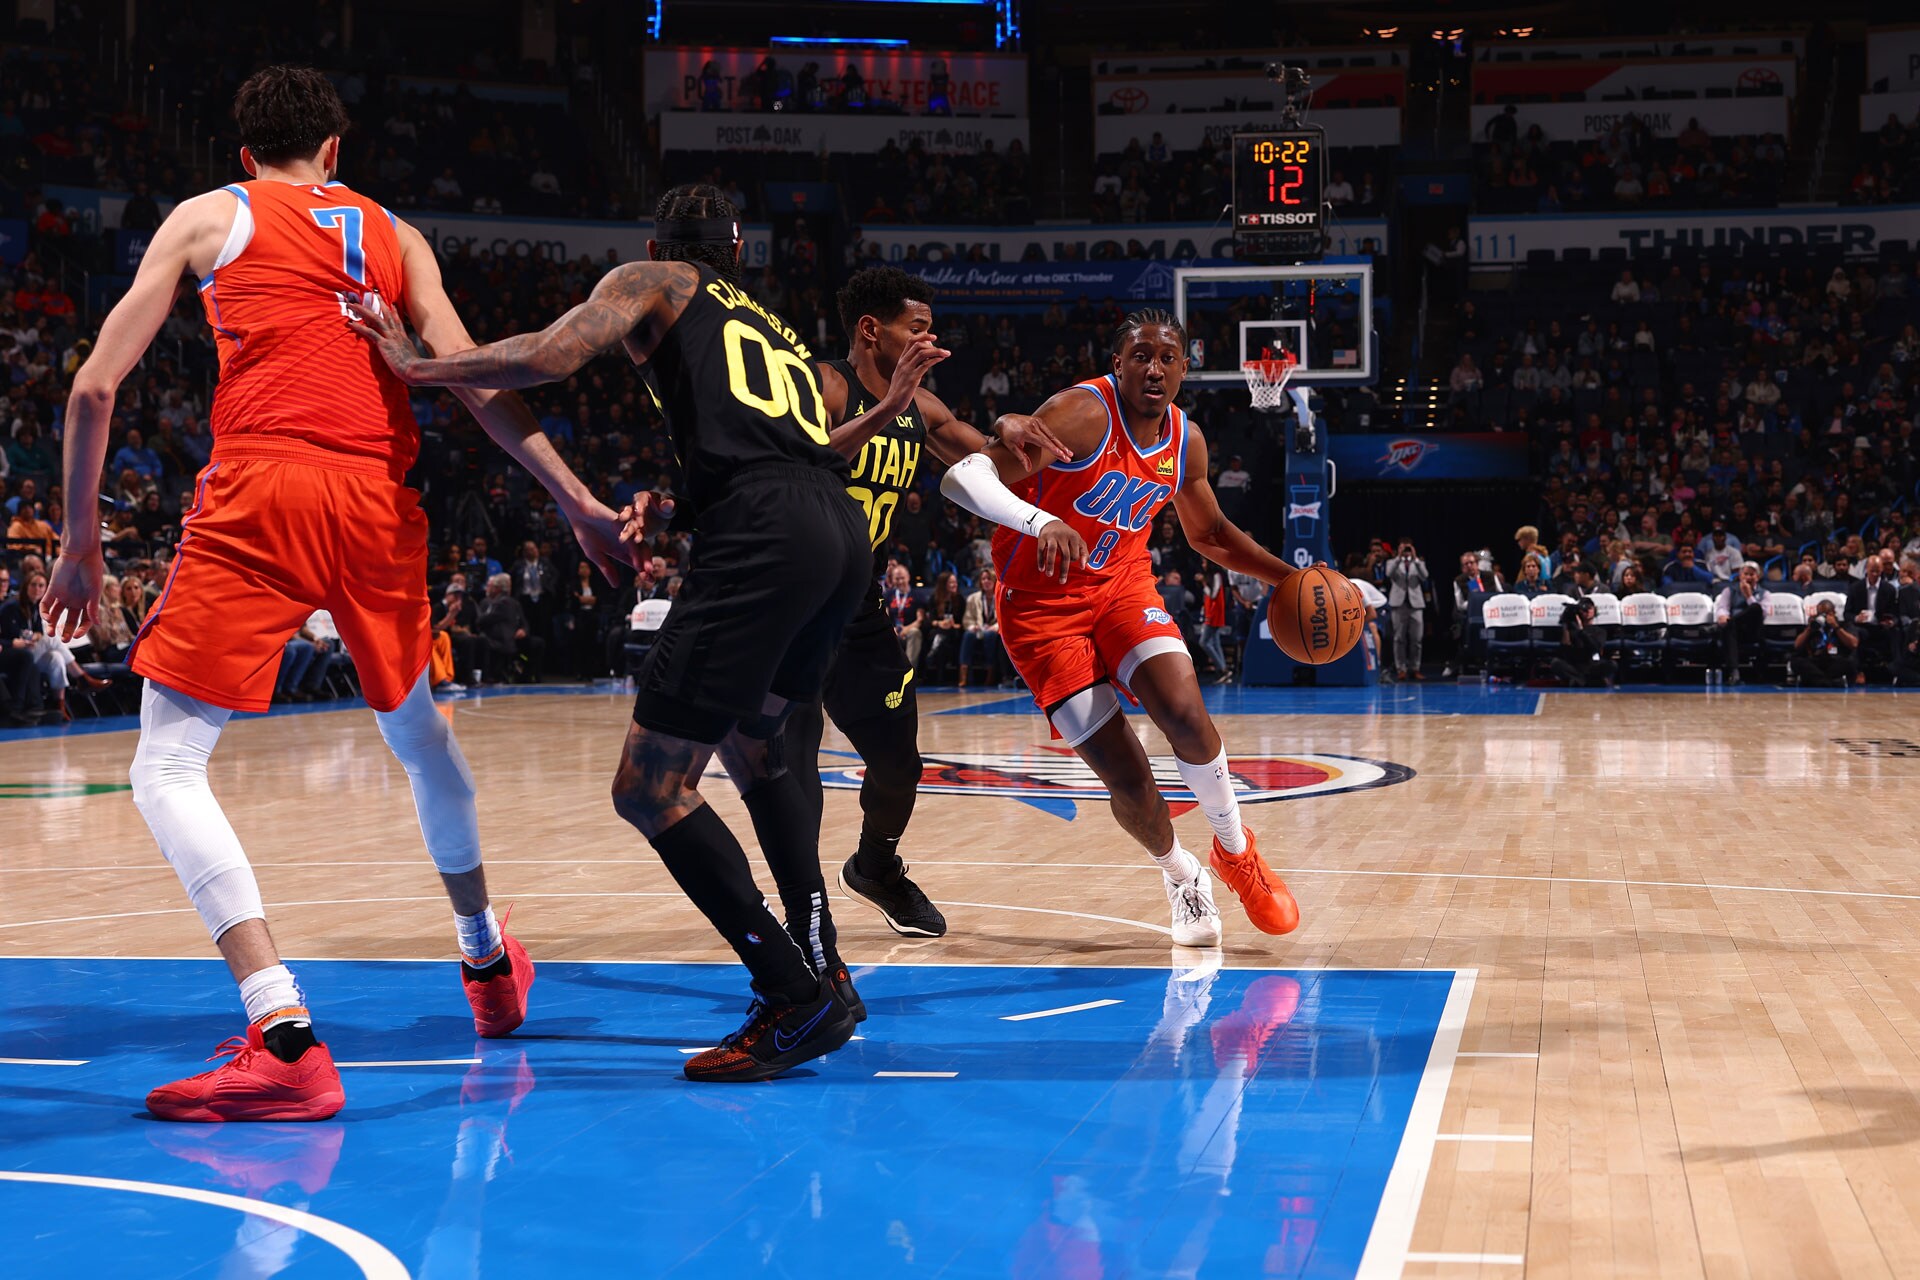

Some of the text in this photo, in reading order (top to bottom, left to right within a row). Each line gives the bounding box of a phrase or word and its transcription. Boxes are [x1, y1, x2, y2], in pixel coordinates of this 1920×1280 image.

[684, 75, 736, 101] PT
[900, 80, 1000, 107] TERACE
[1643, 112, 1672, 131] OAK
[716, 126, 802, 146] POST OAK
[955, 130, 984, 149] OAK
[1254, 141, 1310, 164] 10:22
[1268, 166, 1303, 205] 12
[1260, 212, 1317, 226] TISSOT
[309, 206, 365, 286] 7
[1474, 233, 1516, 260] 111
[1619, 223, 1877, 258] THUNDER
[1022, 273, 1033, 284] of
[1033, 273, 1050, 284] the
[1052, 273, 1071, 284] OKC
[1073, 272, 1113, 284] Thunder
[723, 319, 831, 445] 00
[895, 416, 914, 429] LVT
[1073, 470, 1172, 532] OKC
[1292, 506, 1318, 516] SONIC
[1087, 529, 1120, 570] 8
[1310, 584, 1330, 651] Wilson
